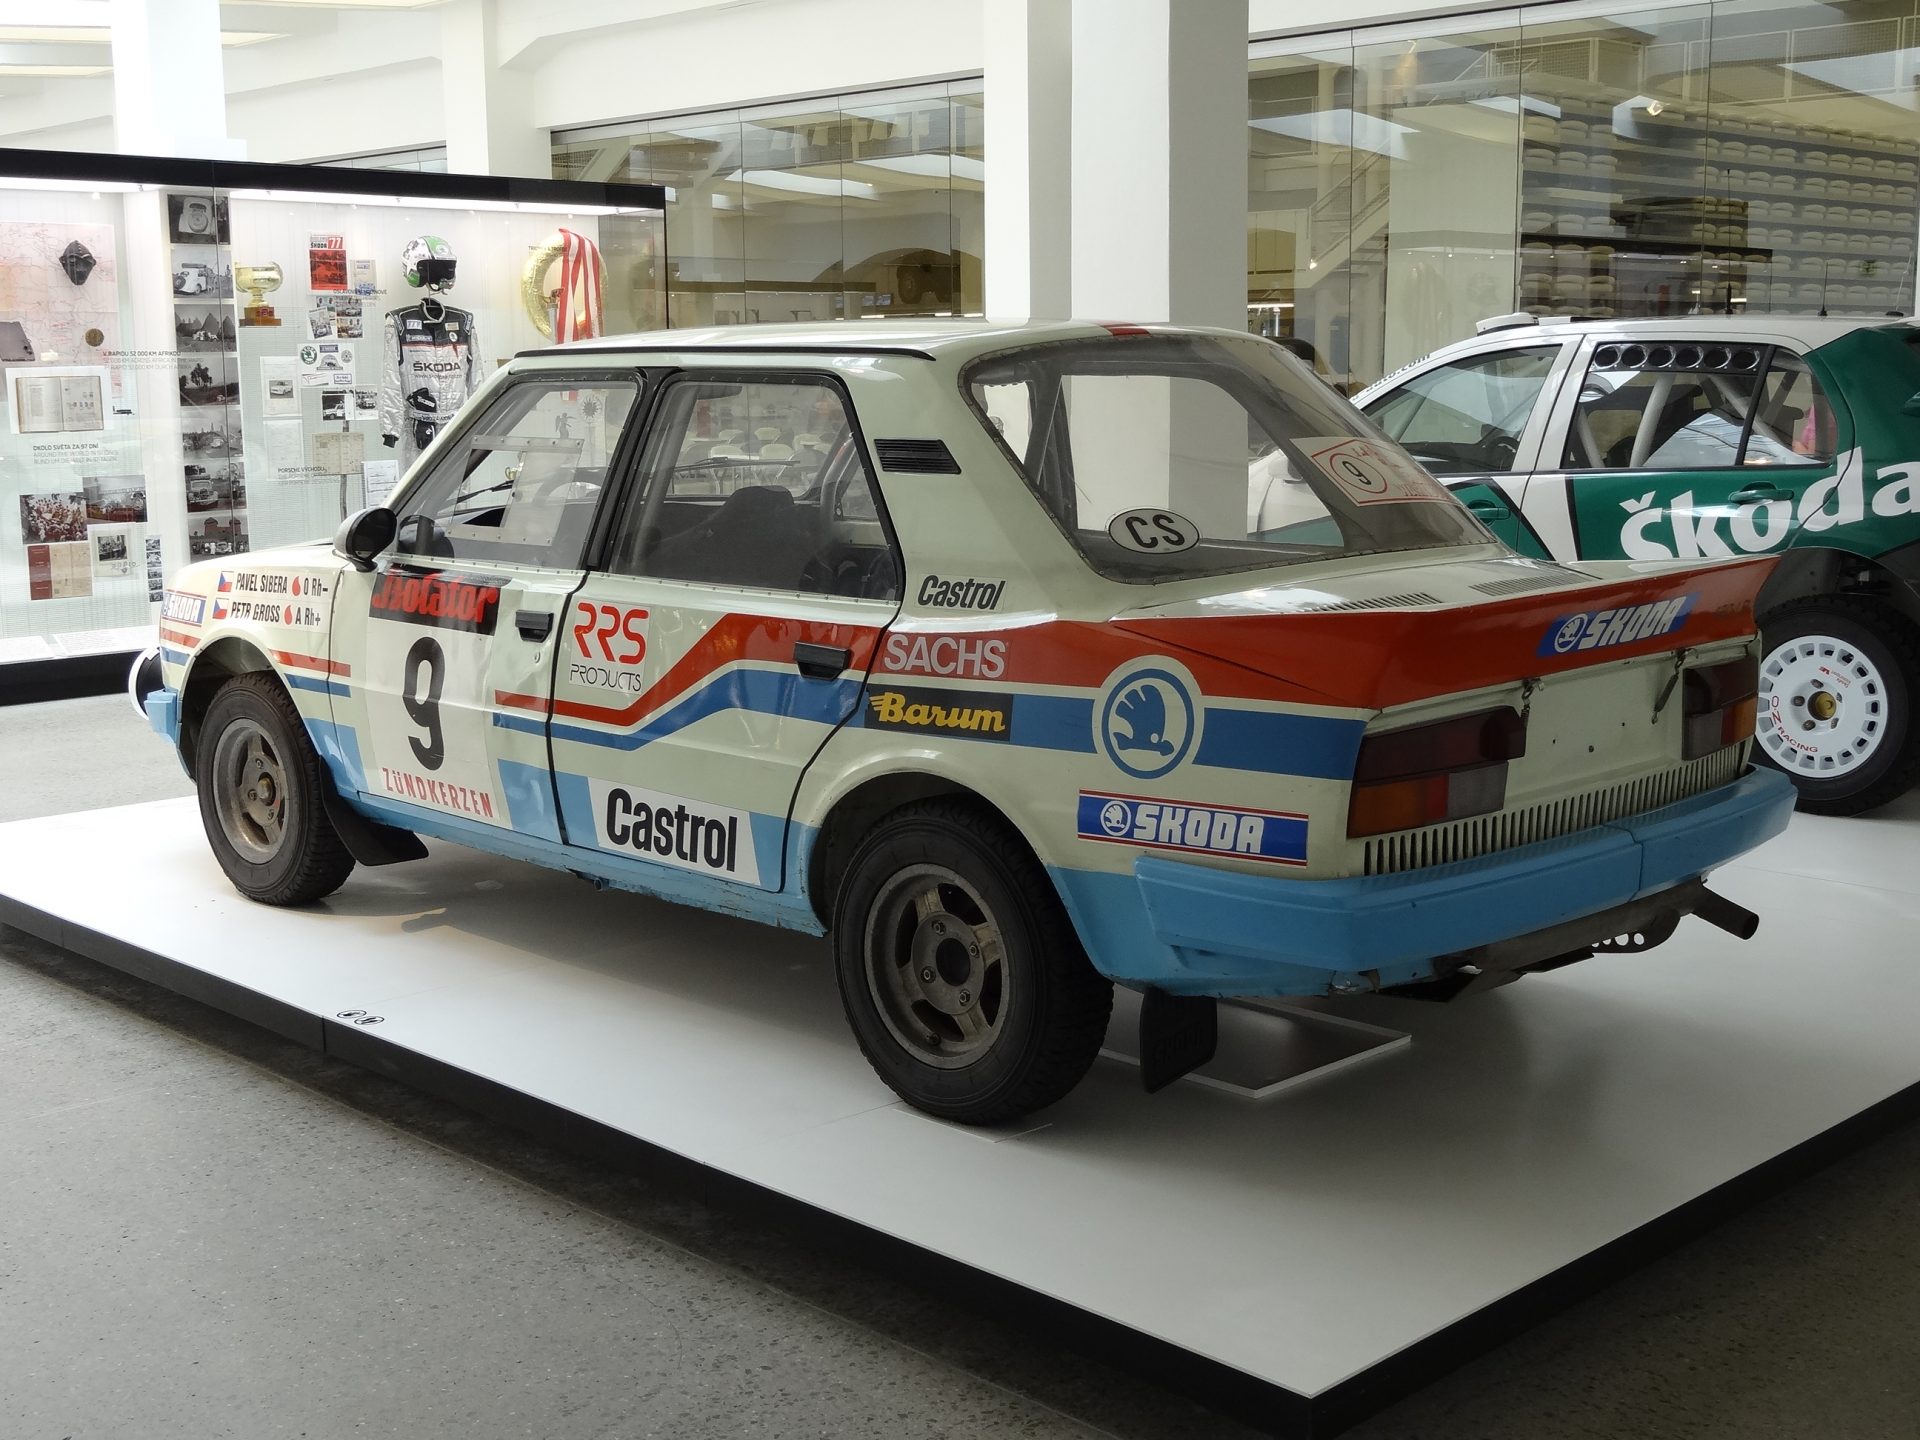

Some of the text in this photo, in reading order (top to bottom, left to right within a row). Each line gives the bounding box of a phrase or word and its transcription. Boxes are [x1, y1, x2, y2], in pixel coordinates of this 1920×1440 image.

[413, 360, 461, 372] ŠKODA
[1341, 461, 1372, 485] 9
[1125, 514, 1185, 548] CS
[235, 573, 258, 592] PAVEL
[260, 574, 288, 594] SIBERA
[918, 575, 1006, 610] Castrol
[167, 594, 202, 622] SKODA
[230, 601, 252, 620] PETR
[252, 604, 281, 623] GROSS
[295, 607, 302, 625] A
[1578, 596, 1687, 650] SKODA
[573, 602, 649, 665] RRS
[884, 633, 1006, 678] SACHS
[570, 663, 642, 692] PRODUCTS
[402, 636, 446, 771] 9
[869, 692, 1006, 732] Barum
[1778, 726, 1818, 753] RACING
[606, 788, 738, 873] Castrol
[1133, 803, 1265, 854] SKODA
